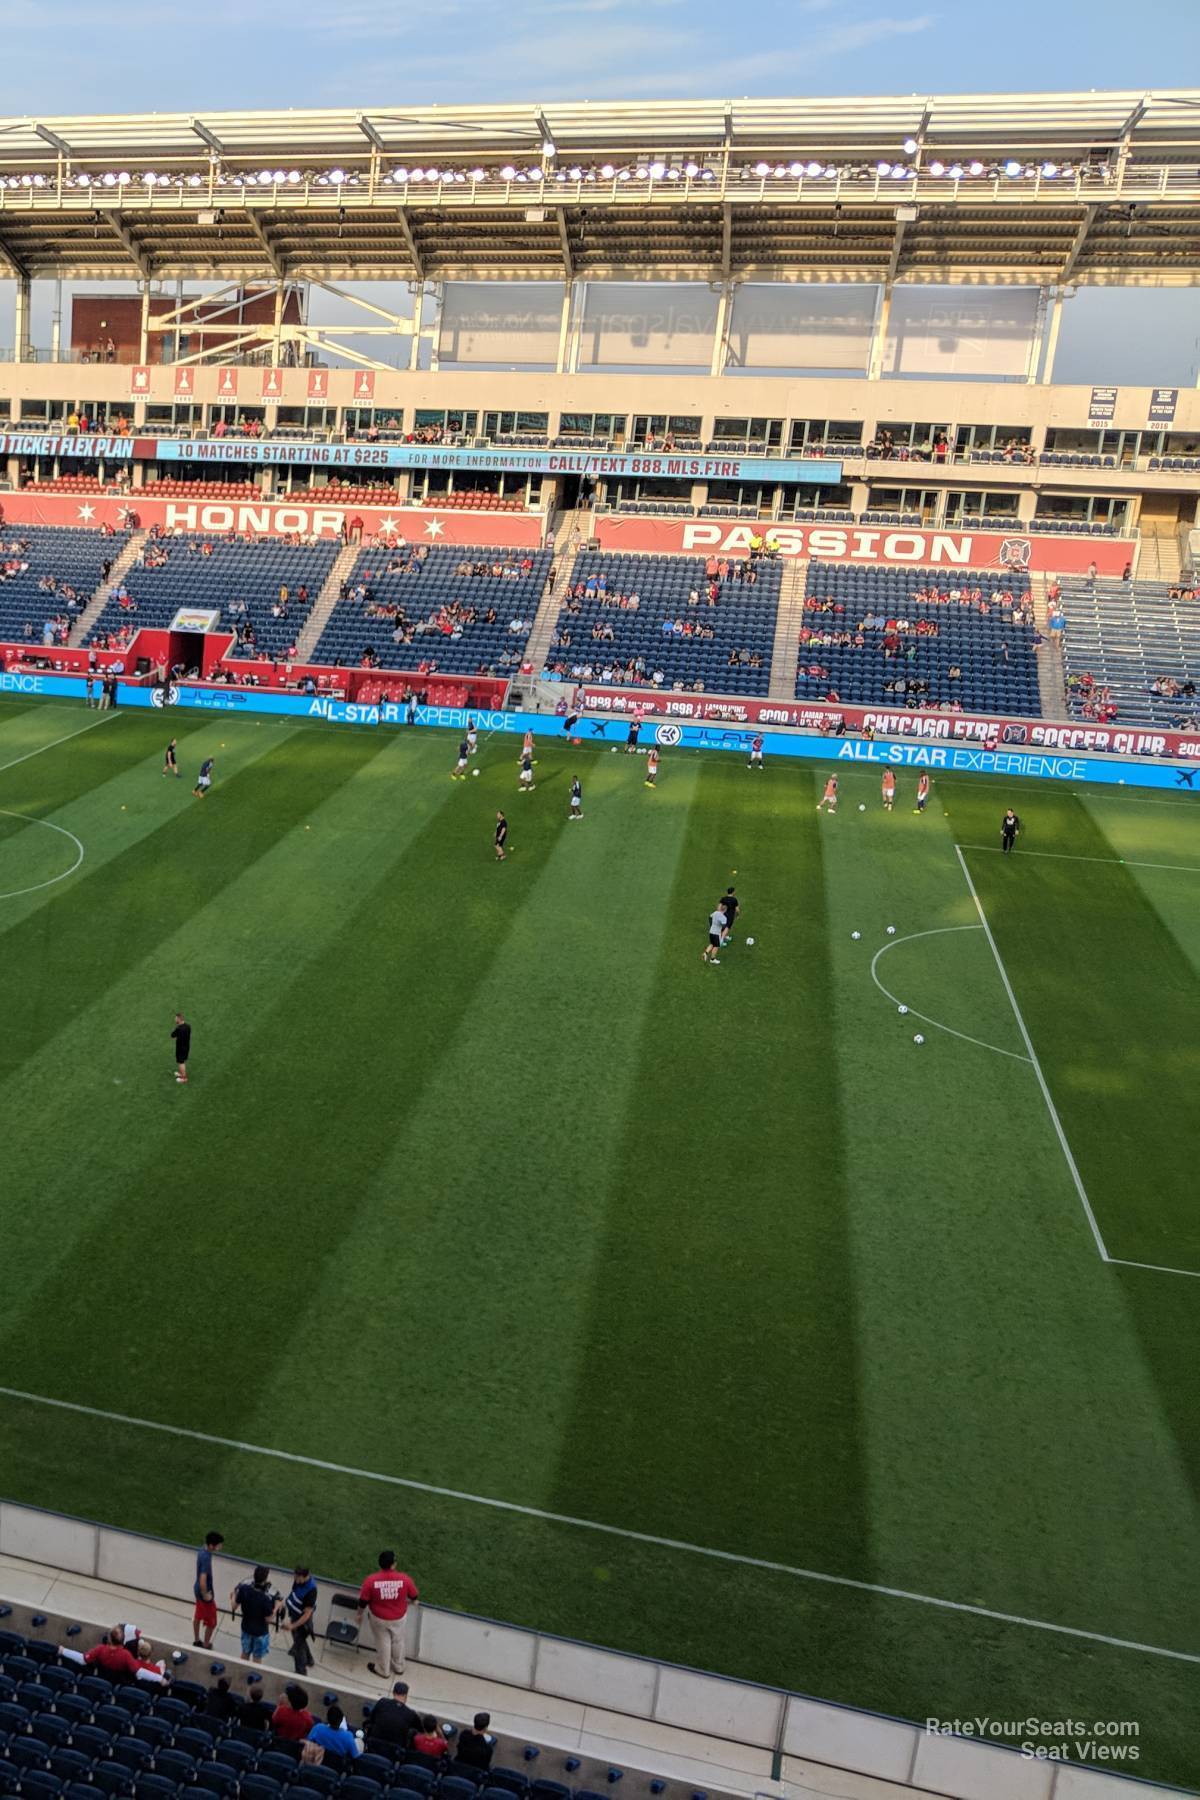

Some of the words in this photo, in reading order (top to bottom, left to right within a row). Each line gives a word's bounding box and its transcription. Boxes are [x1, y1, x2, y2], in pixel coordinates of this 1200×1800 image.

[8, 435, 60, 455] TICKET
[60, 437, 97, 456] FLEX
[95, 439, 134, 458] PLAN
[178, 444, 193, 457] 10
[198, 444, 258, 459] MATCHES
[263, 446, 329, 462] STARTING
[333, 448, 350, 463] AT
[354, 448, 388, 464] $225
[408, 453, 428, 465] FOR
[432, 453, 461, 466] MORE
[466, 454, 542, 468] INFORMATION
[549, 455, 628, 473] CALL/TEXT
[631, 458, 741, 476] 888.MLS.FIRE
[165, 504, 346, 534] HONOR
[681, 524, 973, 563] PASSION
[863, 713, 950, 738] CHICAGO
[1031, 727, 1110, 750] SOCCER
[838, 740, 946, 766] ALL-STAR
[952, 752, 1087, 778] EXPERIENCE
